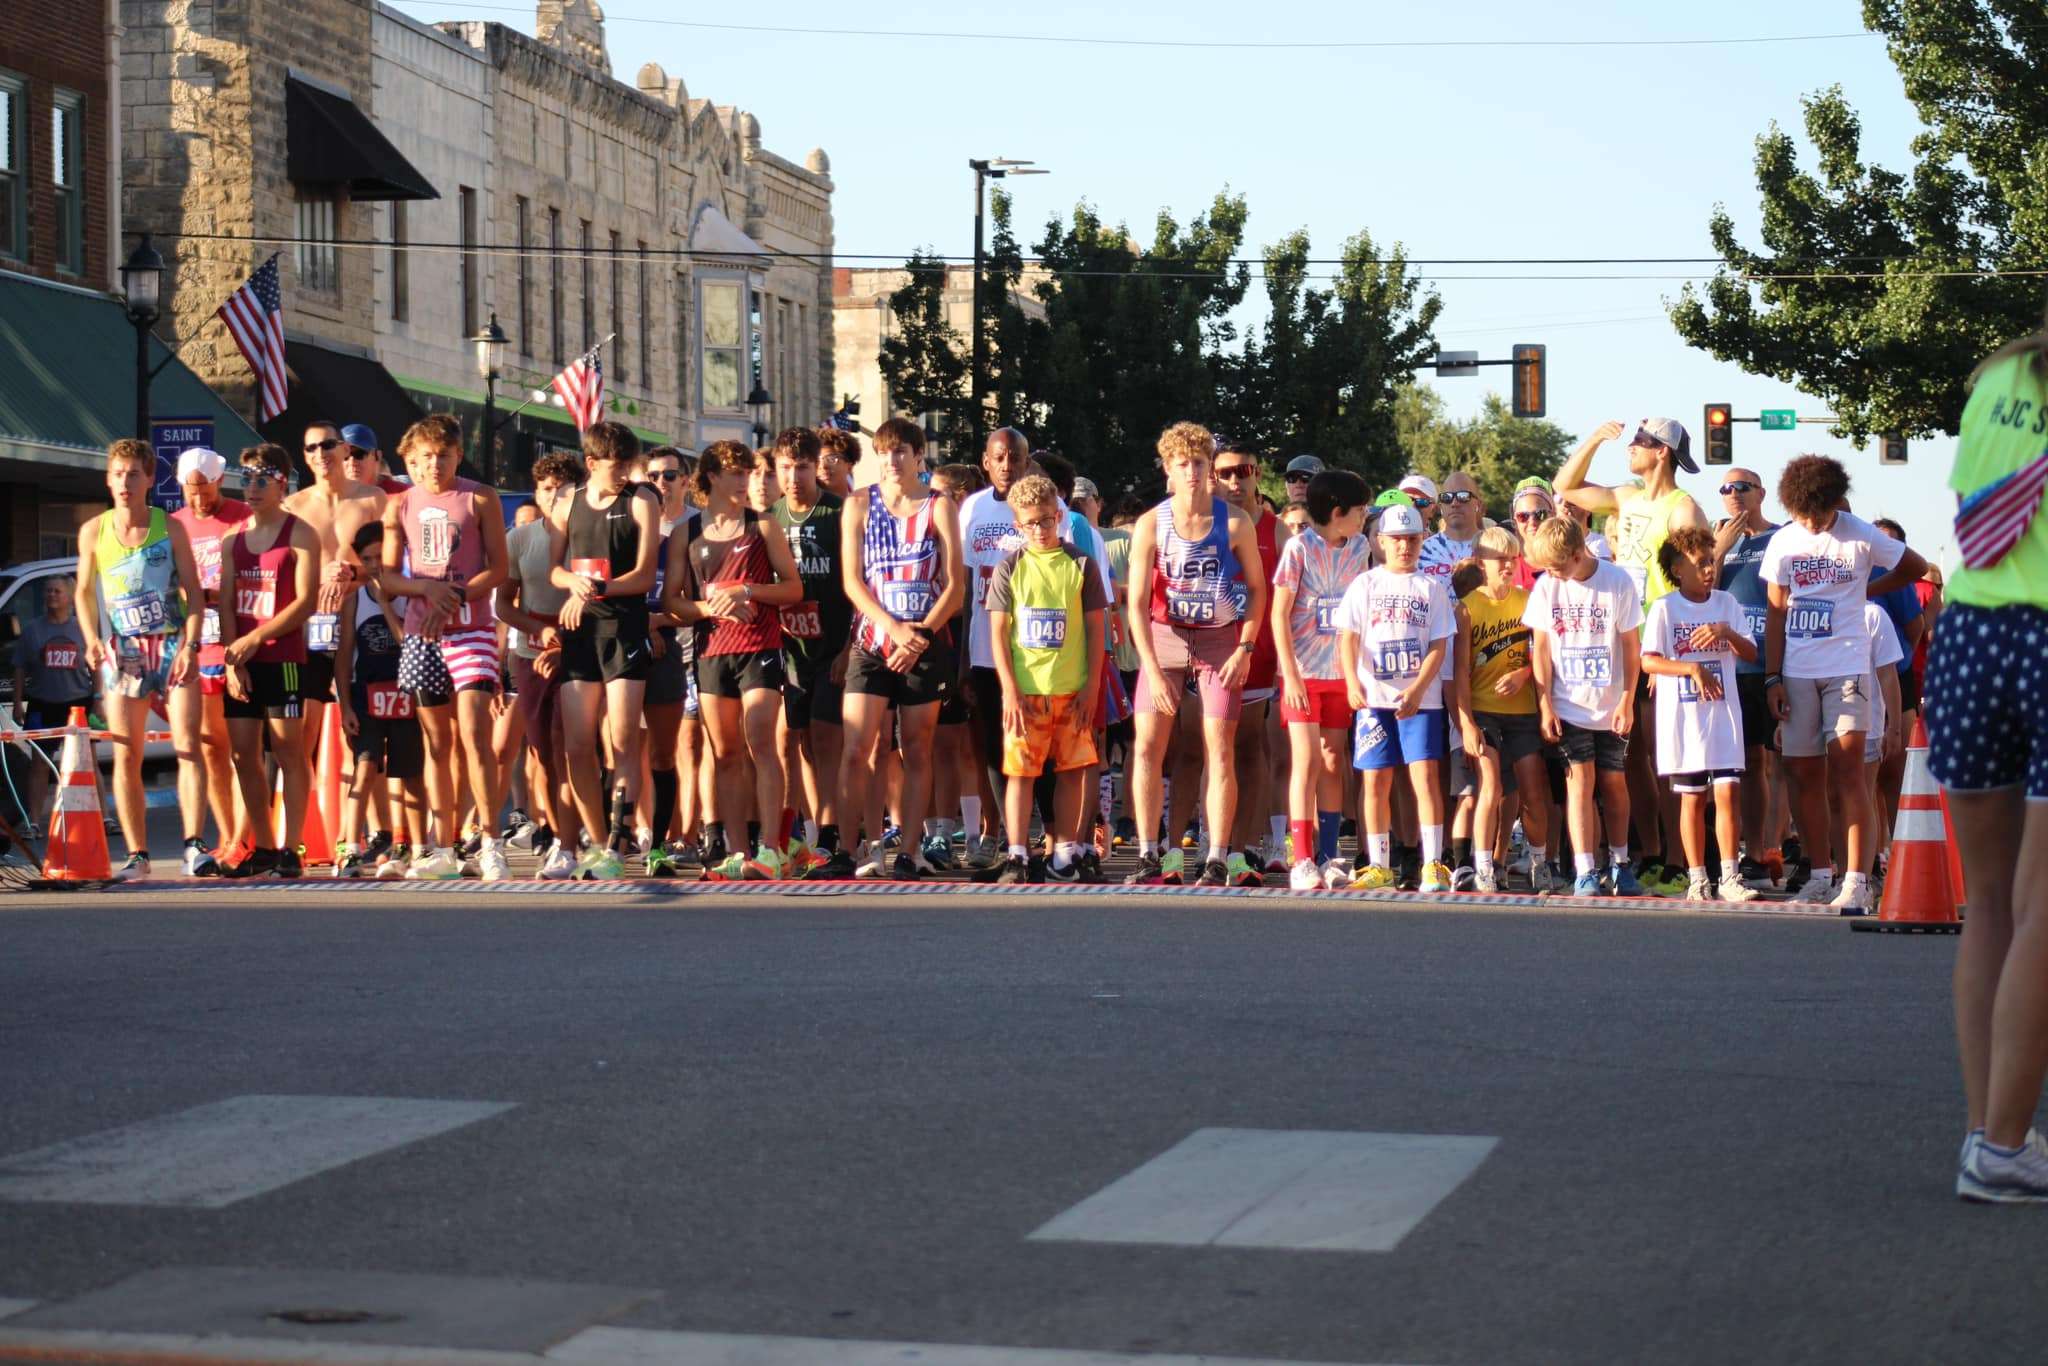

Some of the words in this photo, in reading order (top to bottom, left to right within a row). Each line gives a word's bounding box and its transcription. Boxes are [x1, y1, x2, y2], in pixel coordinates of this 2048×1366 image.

[163, 429, 203, 441] SAINT
[1166, 557, 1220, 580] USA
[1792, 559, 1853, 571] FREEDOM
[1808, 569, 1836, 580] RUN
[237, 590, 274, 617] 1270
[884, 592, 930, 611] 1087
[1168, 600, 1213, 620] 1075
[1375, 598, 1429, 613] REEDOM
[118, 601, 163, 629] 1059
[1791, 610, 1830, 630] 1004
[47, 651, 77, 666] 1287
[1373, 651, 1421, 672] 1005
[1564, 658, 1610, 679] 1033
[373, 691, 411, 716] 973
